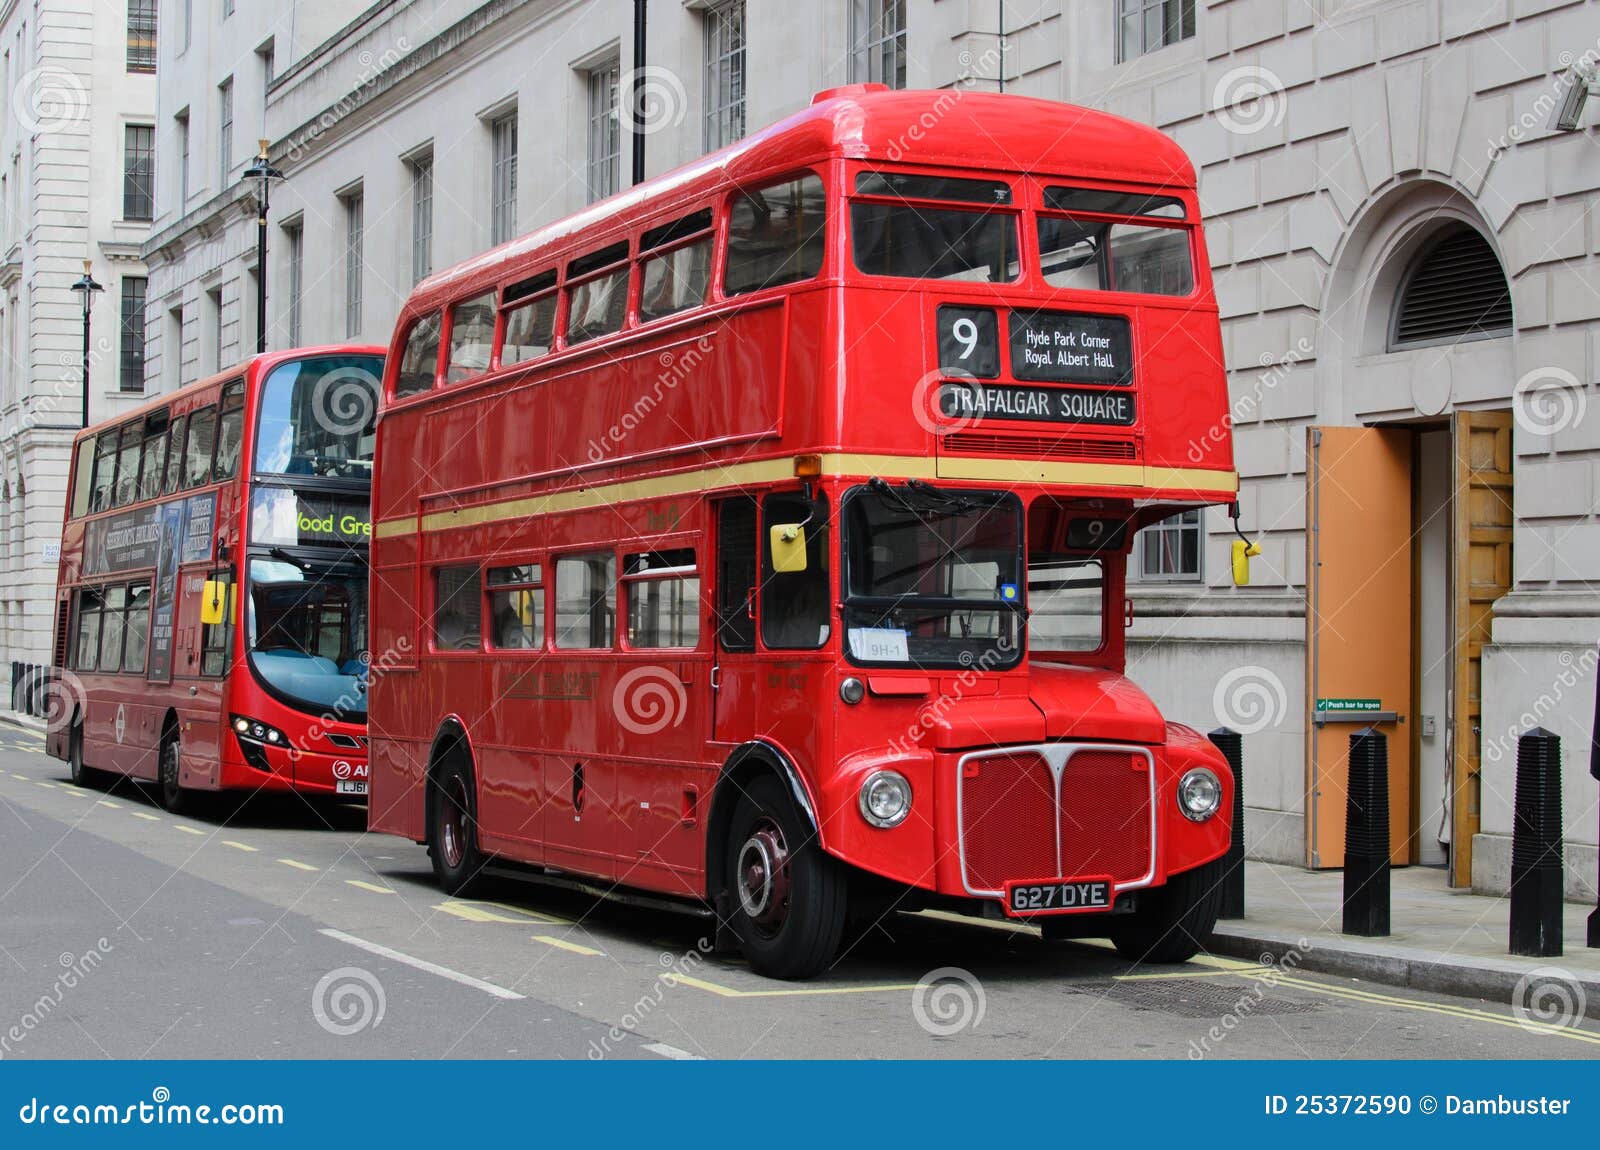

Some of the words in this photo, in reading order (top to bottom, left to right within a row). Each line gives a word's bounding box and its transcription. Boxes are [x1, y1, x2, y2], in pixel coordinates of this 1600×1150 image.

[952, 318, 978, 360] 9
[1026, 329, 1050, 349] Hyde
[1054, 331, 1076, 346] Park
[1081, 332, 1111, 349] Corner
[1025, 350, 1052, 368] Royal
[1057, 353, 1089, 367] Albert
[1094, 354, 1115, 368] Hall
[951, 387, 1050, 415] TRAFALGAR
[1060, 394, 1127, 420] SQUARE
[1088, 520, 1104, 545] 9
[871, 644, 901, 657] 9H-1
[1014, 886, 1056, 909] 627
[1062, 883, 1105, 906] DYE
